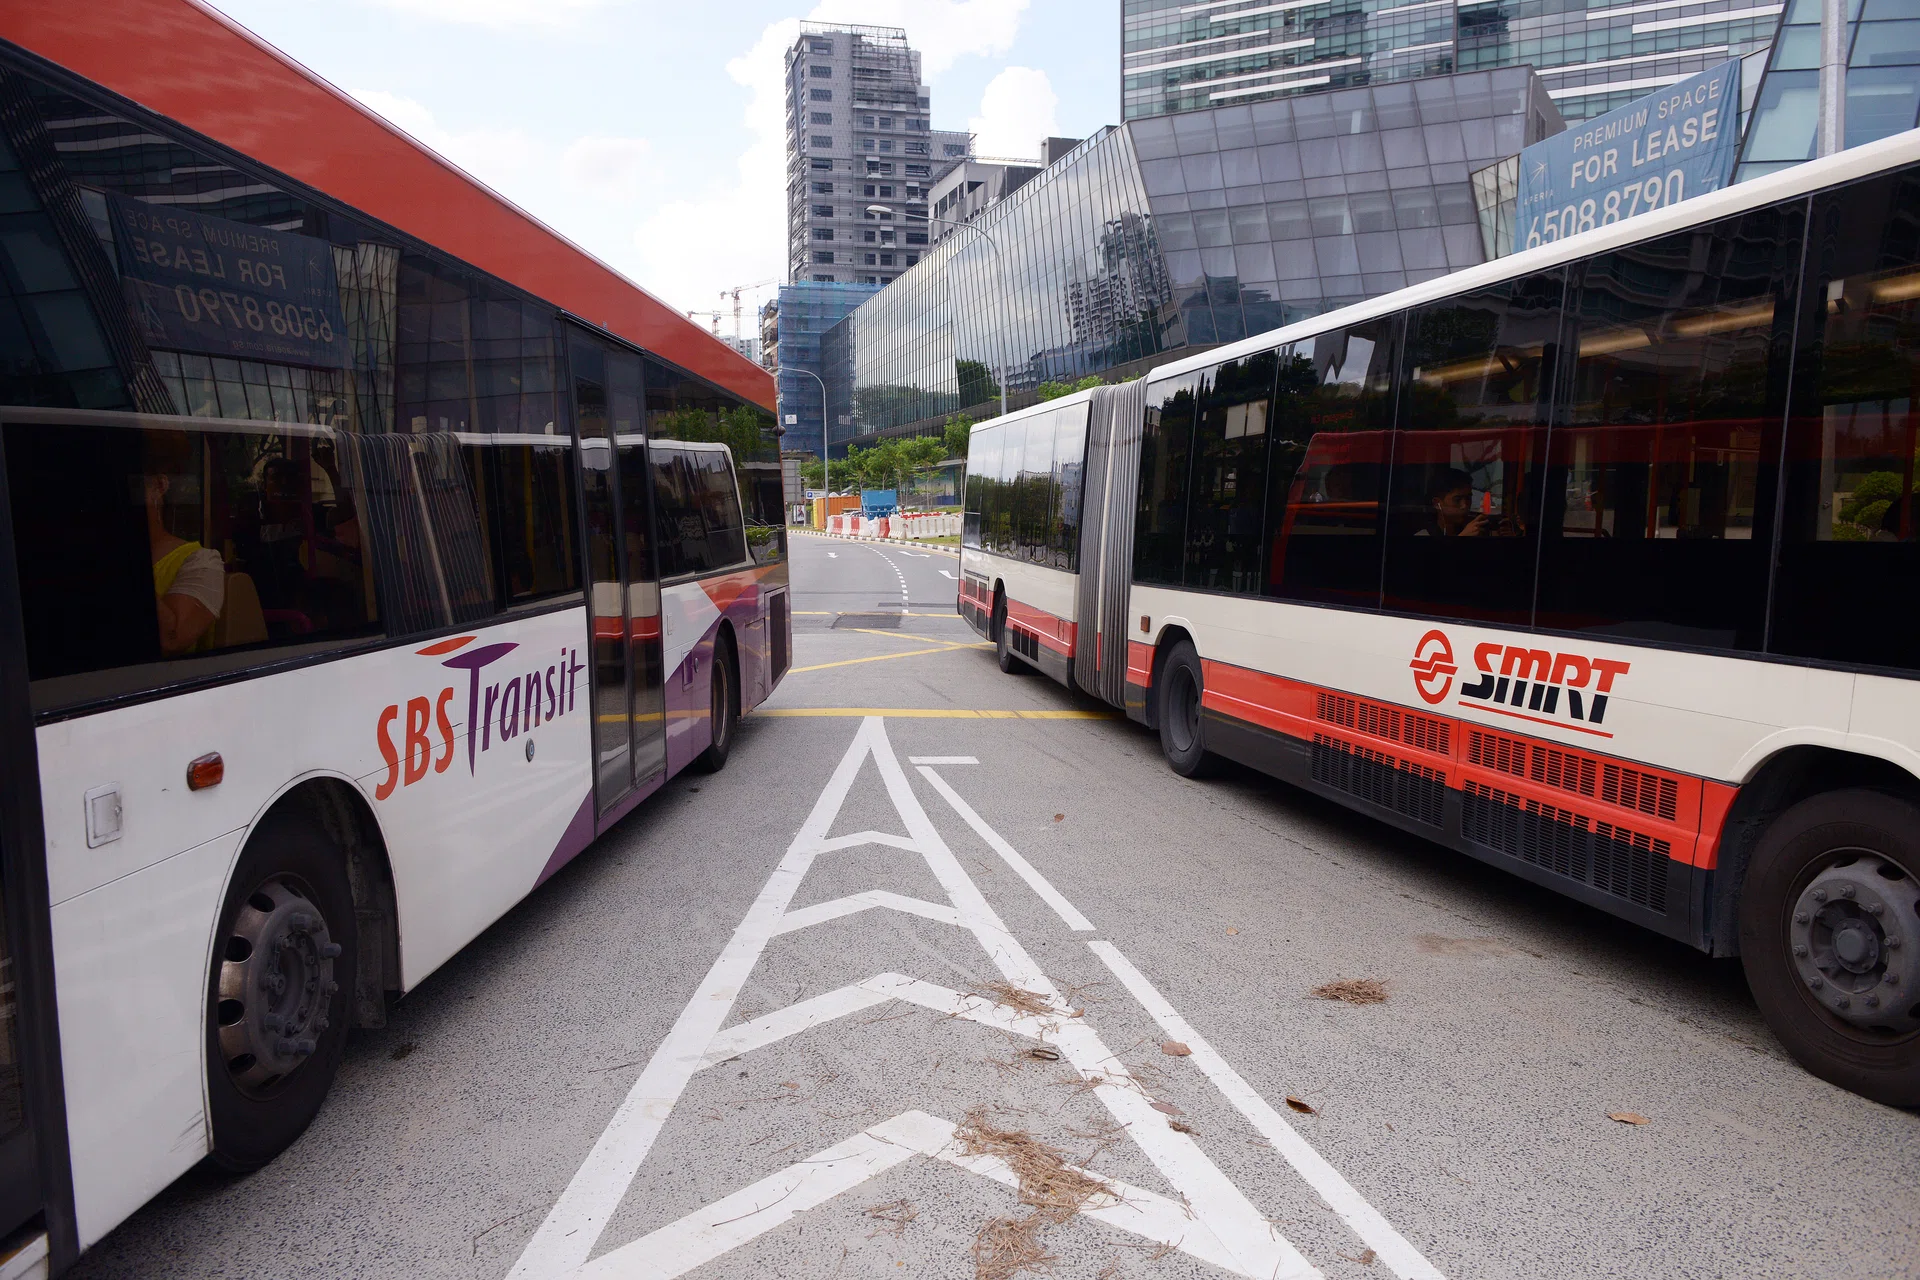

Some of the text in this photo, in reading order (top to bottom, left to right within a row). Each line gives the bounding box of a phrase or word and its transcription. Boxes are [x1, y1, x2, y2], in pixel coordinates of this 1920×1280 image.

[1571, 108, 1718, 189] FOR LEASE
[1573, 78, 1720, 153] PREMIUM SPACE
[375, 642, 586, 801] SBS Transit
[1460, 642, 1631, 724] SMRT
